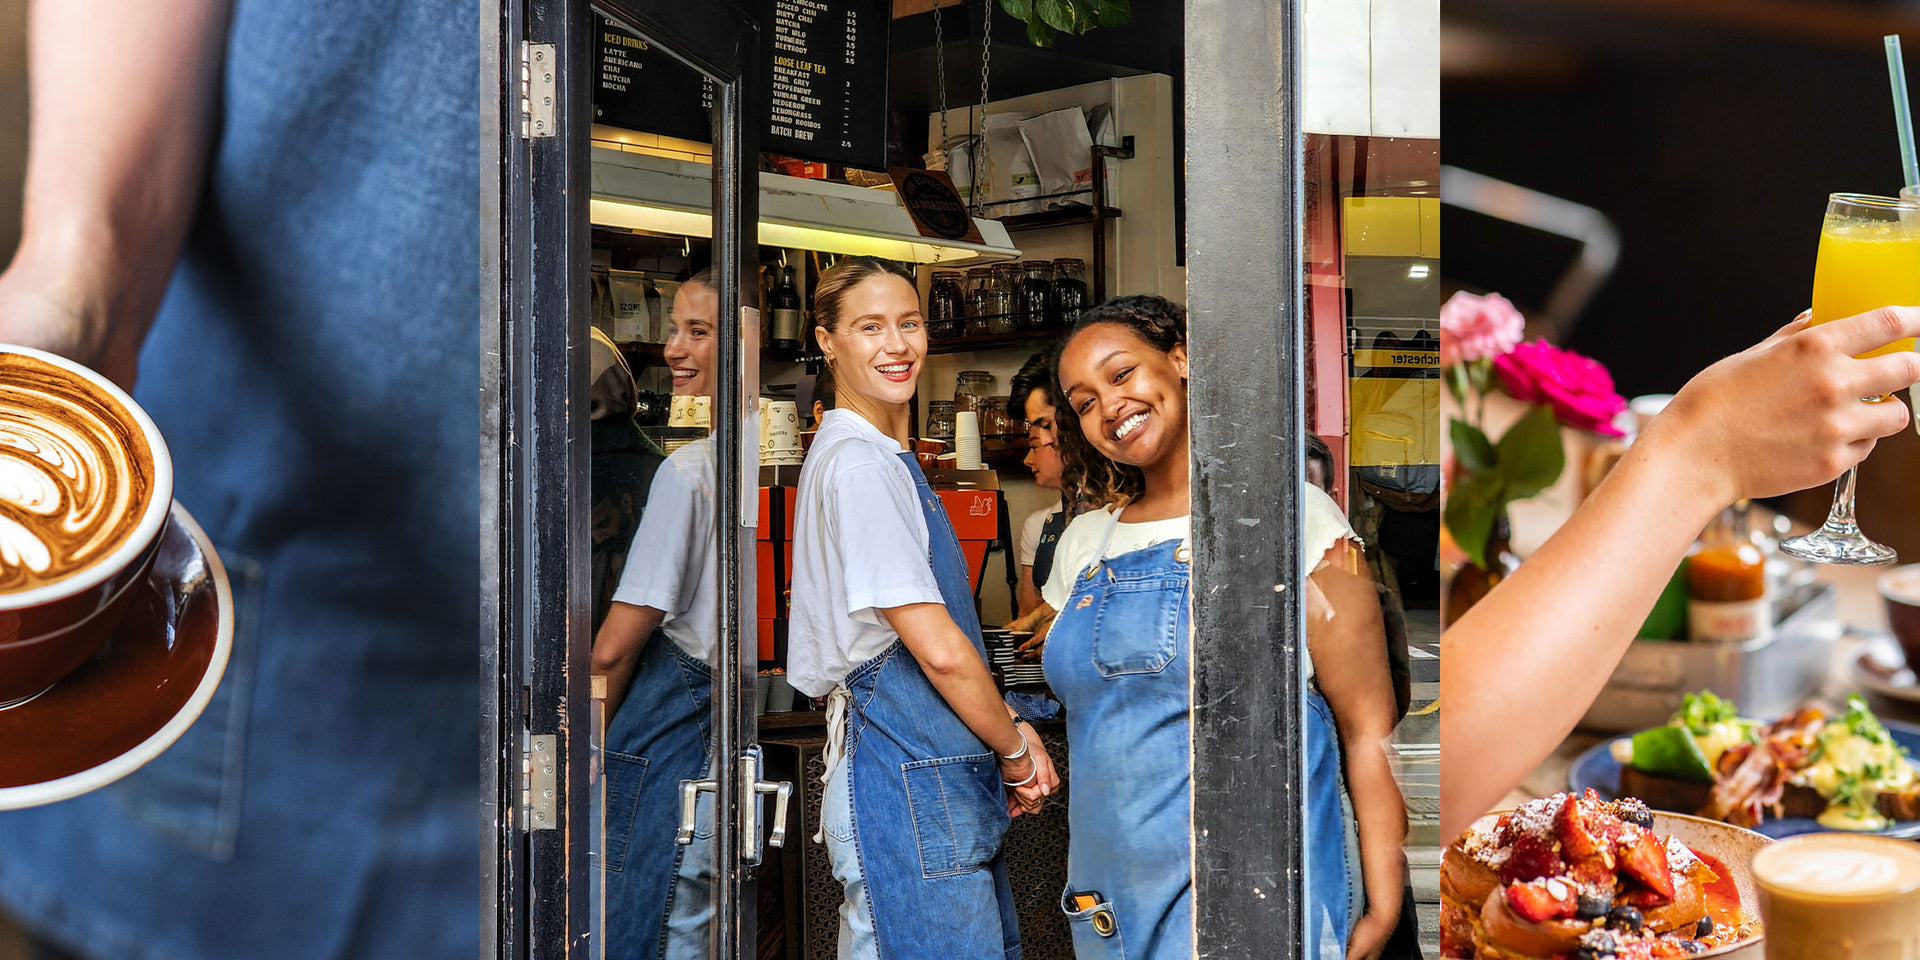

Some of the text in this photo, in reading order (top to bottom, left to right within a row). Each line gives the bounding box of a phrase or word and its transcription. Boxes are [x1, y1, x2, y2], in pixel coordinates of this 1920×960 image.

[777, 2, 817, 16] SPICED CHAI
[793, 0, 828, 11] CHOCOLATE
[776, 10, 813, 23] DIRTY CHAI
[776, 18, 800, 29] MATCHA
[776, 26, 788, 34] HOT
[604, 33, 648, 51] ICED DRINKS
[776, 34, 805, 46] TURMERIC
[604, 47, 627, 57] LATTE
[775, 42, 807, 54] BEETROOT
[604, 56, 642, 69] AMERICANO
[774, 55, 826, 74] LOOSE LEAF TEA
[603, 65, 620, 73] CHAI
[774, 66, 810, 79] BREAKFAST
[603, 73, 631, 84] MATCHA
[774, 74, 810, 87] EARL GREY
[602, 81, 626, 92] MOCHA
[773, 82, 811, 95] PEPPERMINT
[772, 98, 805, 110] HEDGEROW
[773, 90, 821, 106] YUNNAN GREEN
[772, 107, 812, 119] LEMONGRASS
[771, 115, 821, 129] MANGO ROOIBOS
[771, 125, 814, 141] BATCH BREW
